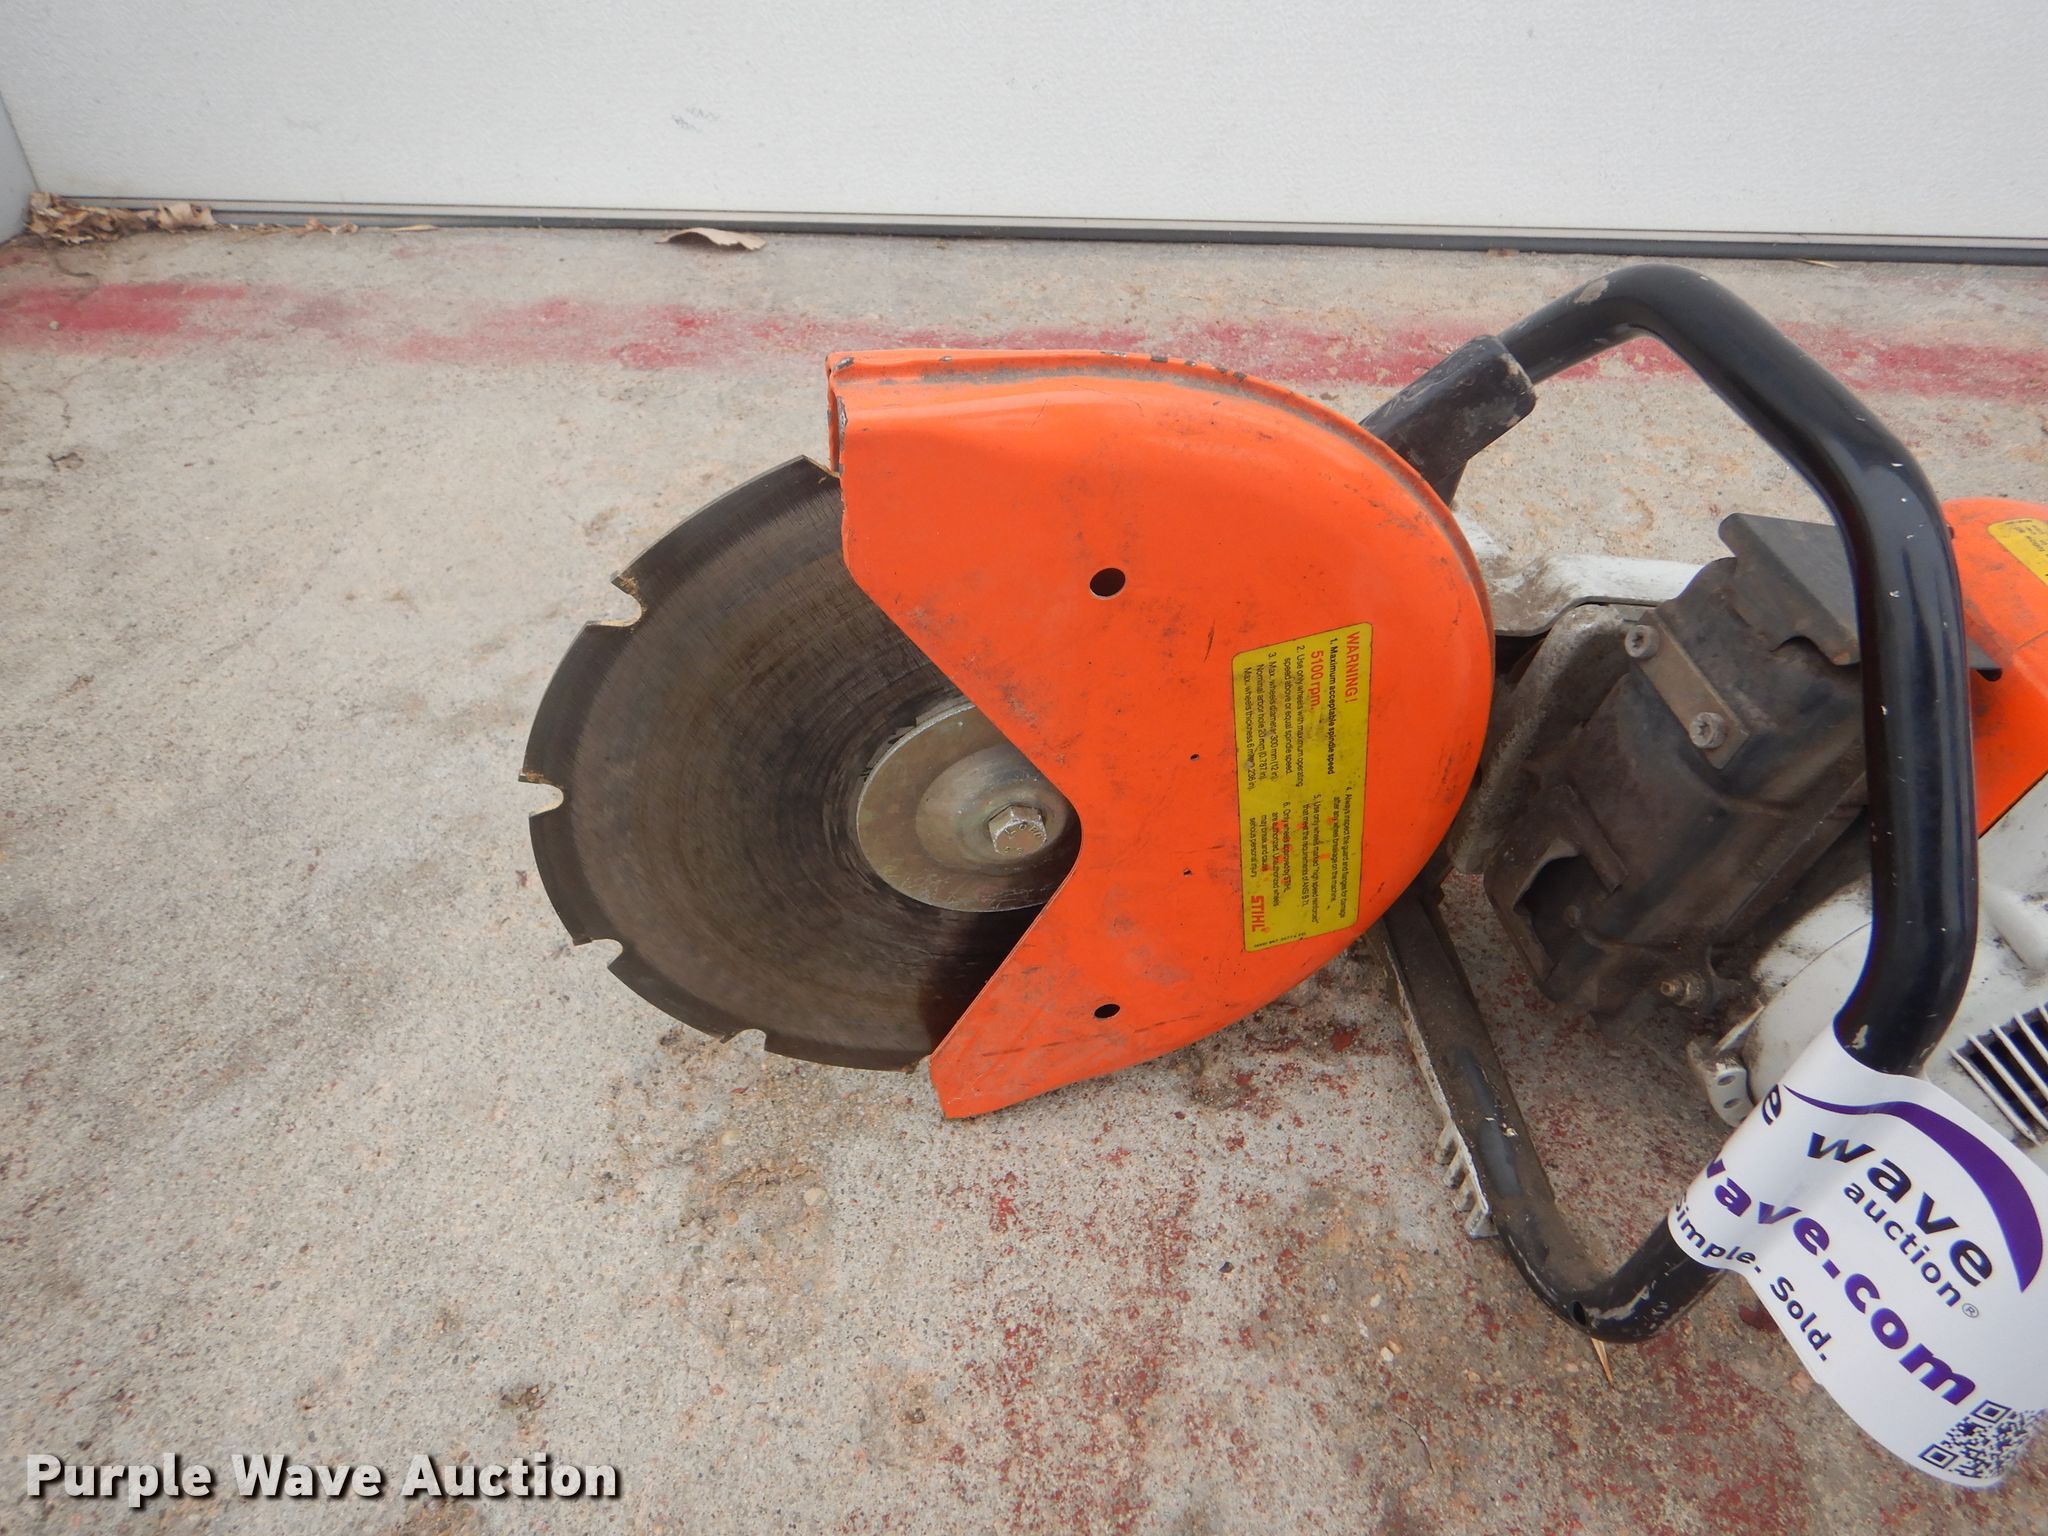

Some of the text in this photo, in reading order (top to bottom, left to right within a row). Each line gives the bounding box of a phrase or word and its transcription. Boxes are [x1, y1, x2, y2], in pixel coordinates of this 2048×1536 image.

[1297, 645, 1305, 653] 2.
[1244, 667, 1252, 685] Max.
[1284, 658, 1293, 680] speed
[1330, 646, 1338, 685] Maximum
[1256, 664, 1264, 693] Nominal
[1295, 670, 1304, 684] only
[1308, 651, 1324, 710] 5100 rpm.
[1245, 686, 1253, 710] wheels
[1284, 681, 1292, 702] above
[1328, 686, 1336, 726] acceptable
[1246, 711, 1254, 743] thickness
[1258, 714, 1266, 728] hole
[1284, 711, 1292, 729] equal
[1258, 729, 1266, 737] 20
[1284, 730, 1293, 753] spindle
[1326, 727, 1336, 752] spindle
[1259, 739, 1265, 751] mm
[1271, 749, 1277, 761] mm
[1270, 761, 1279, 771] (12
[1327, 754, 1335, 775] speed
[1313, 801, 1321, 813] Use
[1343, 794, 1352, 814] Always
[1251, 895, 1265, 932] STIHL
[1806, 1131, 1993, 1287] wave
[1770, 1275, 1832, 1361] Sold.
